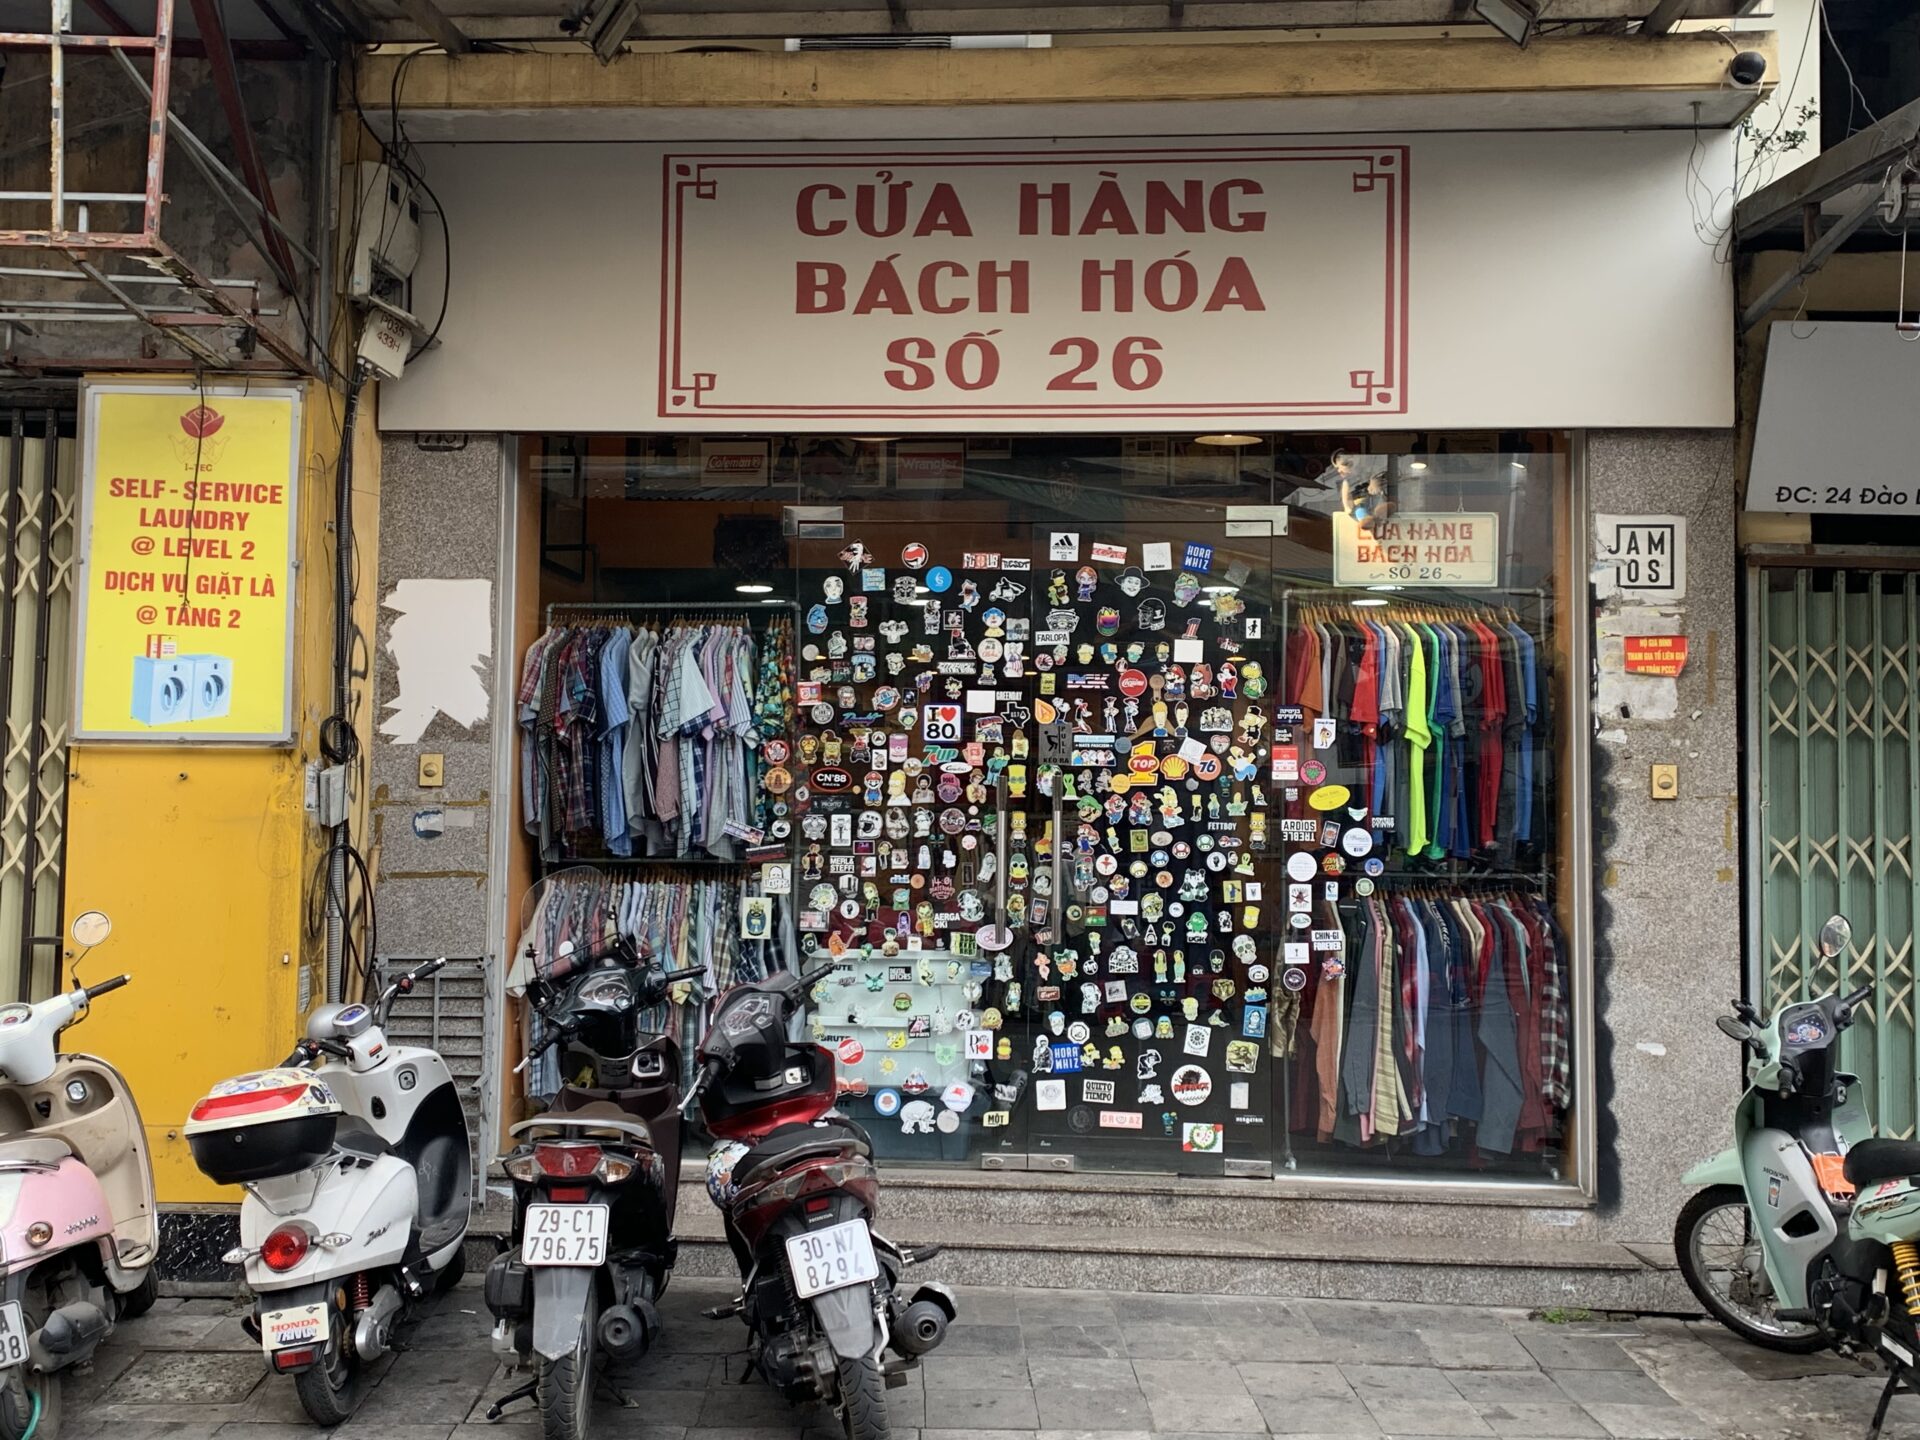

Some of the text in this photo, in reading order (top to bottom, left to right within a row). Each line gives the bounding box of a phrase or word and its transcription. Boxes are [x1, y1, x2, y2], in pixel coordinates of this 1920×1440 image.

[795, 170, 1267, 238] CỬA HÀNG
[795, 249, 1266, 315] BÁCH HÓA
[884, 328, 1164, 391] SỐ 26
[902, 457, 961, 476] Wrangler
[1775, 486, 1817, 503] ĐC:
[1825, 487, 1851, 504] 24
[1859, 485, 1908, 505] Đào
[139, 508, 250, 531] LAUNDRY
[131, 536, 256, 560] @ LEVEL 2
[1187, 545, 1212, 559] HORA
[1184, 555, 1209, 570] WHIZ
[1389, 562, 1442, 580] SỐ 26
[105, 571, 275, 600] DỊCH VỤ GIẶT LÀ
[137, 605, 158, 625] @
[228, 609, 241, 629] 2
[1037, 632, 1068, 642] FARLOPA
[927, 724, 956, 739] 80
[1132, 758, 1157, 769] TOP
[1199, 760, 1217, 774] 76
[1207, 821, 1237, 831] FETTBOY
[934, 920, 948, 929] OKI
[1314, 931, 1340, 941] CHIN-GI
[1054, 1047, 1079, 1059] HORA
[1055, 1058, 1080, 1070] WHIZ
[1085, 1081, 1113, 1092] QUIETO
[1085, 1090, 1112, 1101] TIEMPO
[538, 1209, 593, 1233] 29-C1
[529, 1237, 599, 1261] 796.75
[800, 1227, 854, 1263] 30-N7
[270, 1318, 320, 1332] HONDA
